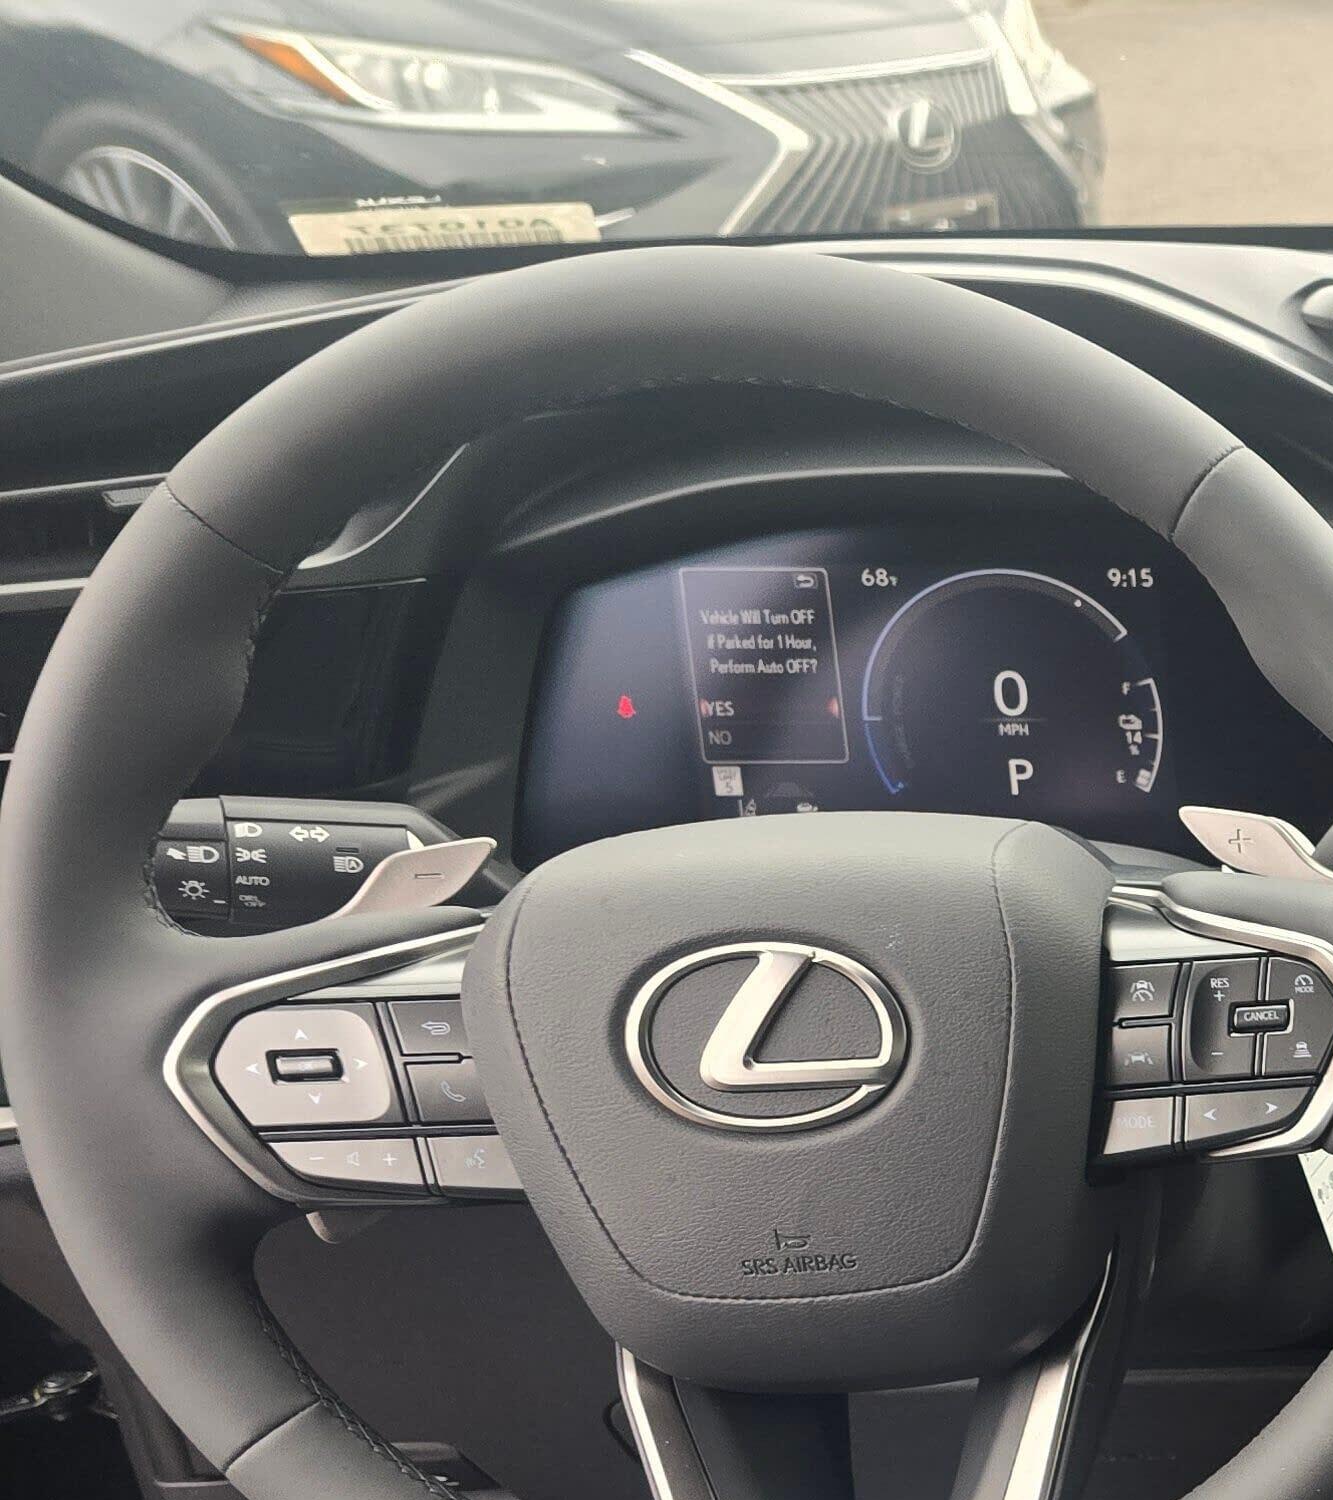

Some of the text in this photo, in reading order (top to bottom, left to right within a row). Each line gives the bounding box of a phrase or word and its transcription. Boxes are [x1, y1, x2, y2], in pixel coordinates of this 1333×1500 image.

[1107, 568, 1154, 588] 9:15
[701, 609, 815, 625] Vehicle Will Turn OFF
[717, 634, 756, 650] Parked
[757, 634, 775, 649] for
[777, 636, 783, 649] 1
[785, 634, 817, 651] Hour,
[710, 658, 818, 674] Perform Auto OFF?
[993, 670, 1029, 717] 0
[708, 701, 735, 717] YES
[708, 730, 732, 746] NO
[998, 724, 1030, 737] MPH
[1126, 731, 1143, 744] 14
[1008, 758, 1034, 796] P
[235, 876, 270, 886] AUTO
[1210, 978, 1230, 988] RES
[1295, 985, 1315, 994] MODE
[1243, 1011, 1280, 1022] CANCEL
[1116, 1115, 1155, 1129] MODE
[742, 1253, 858, 1276] SRS AIRBAG
